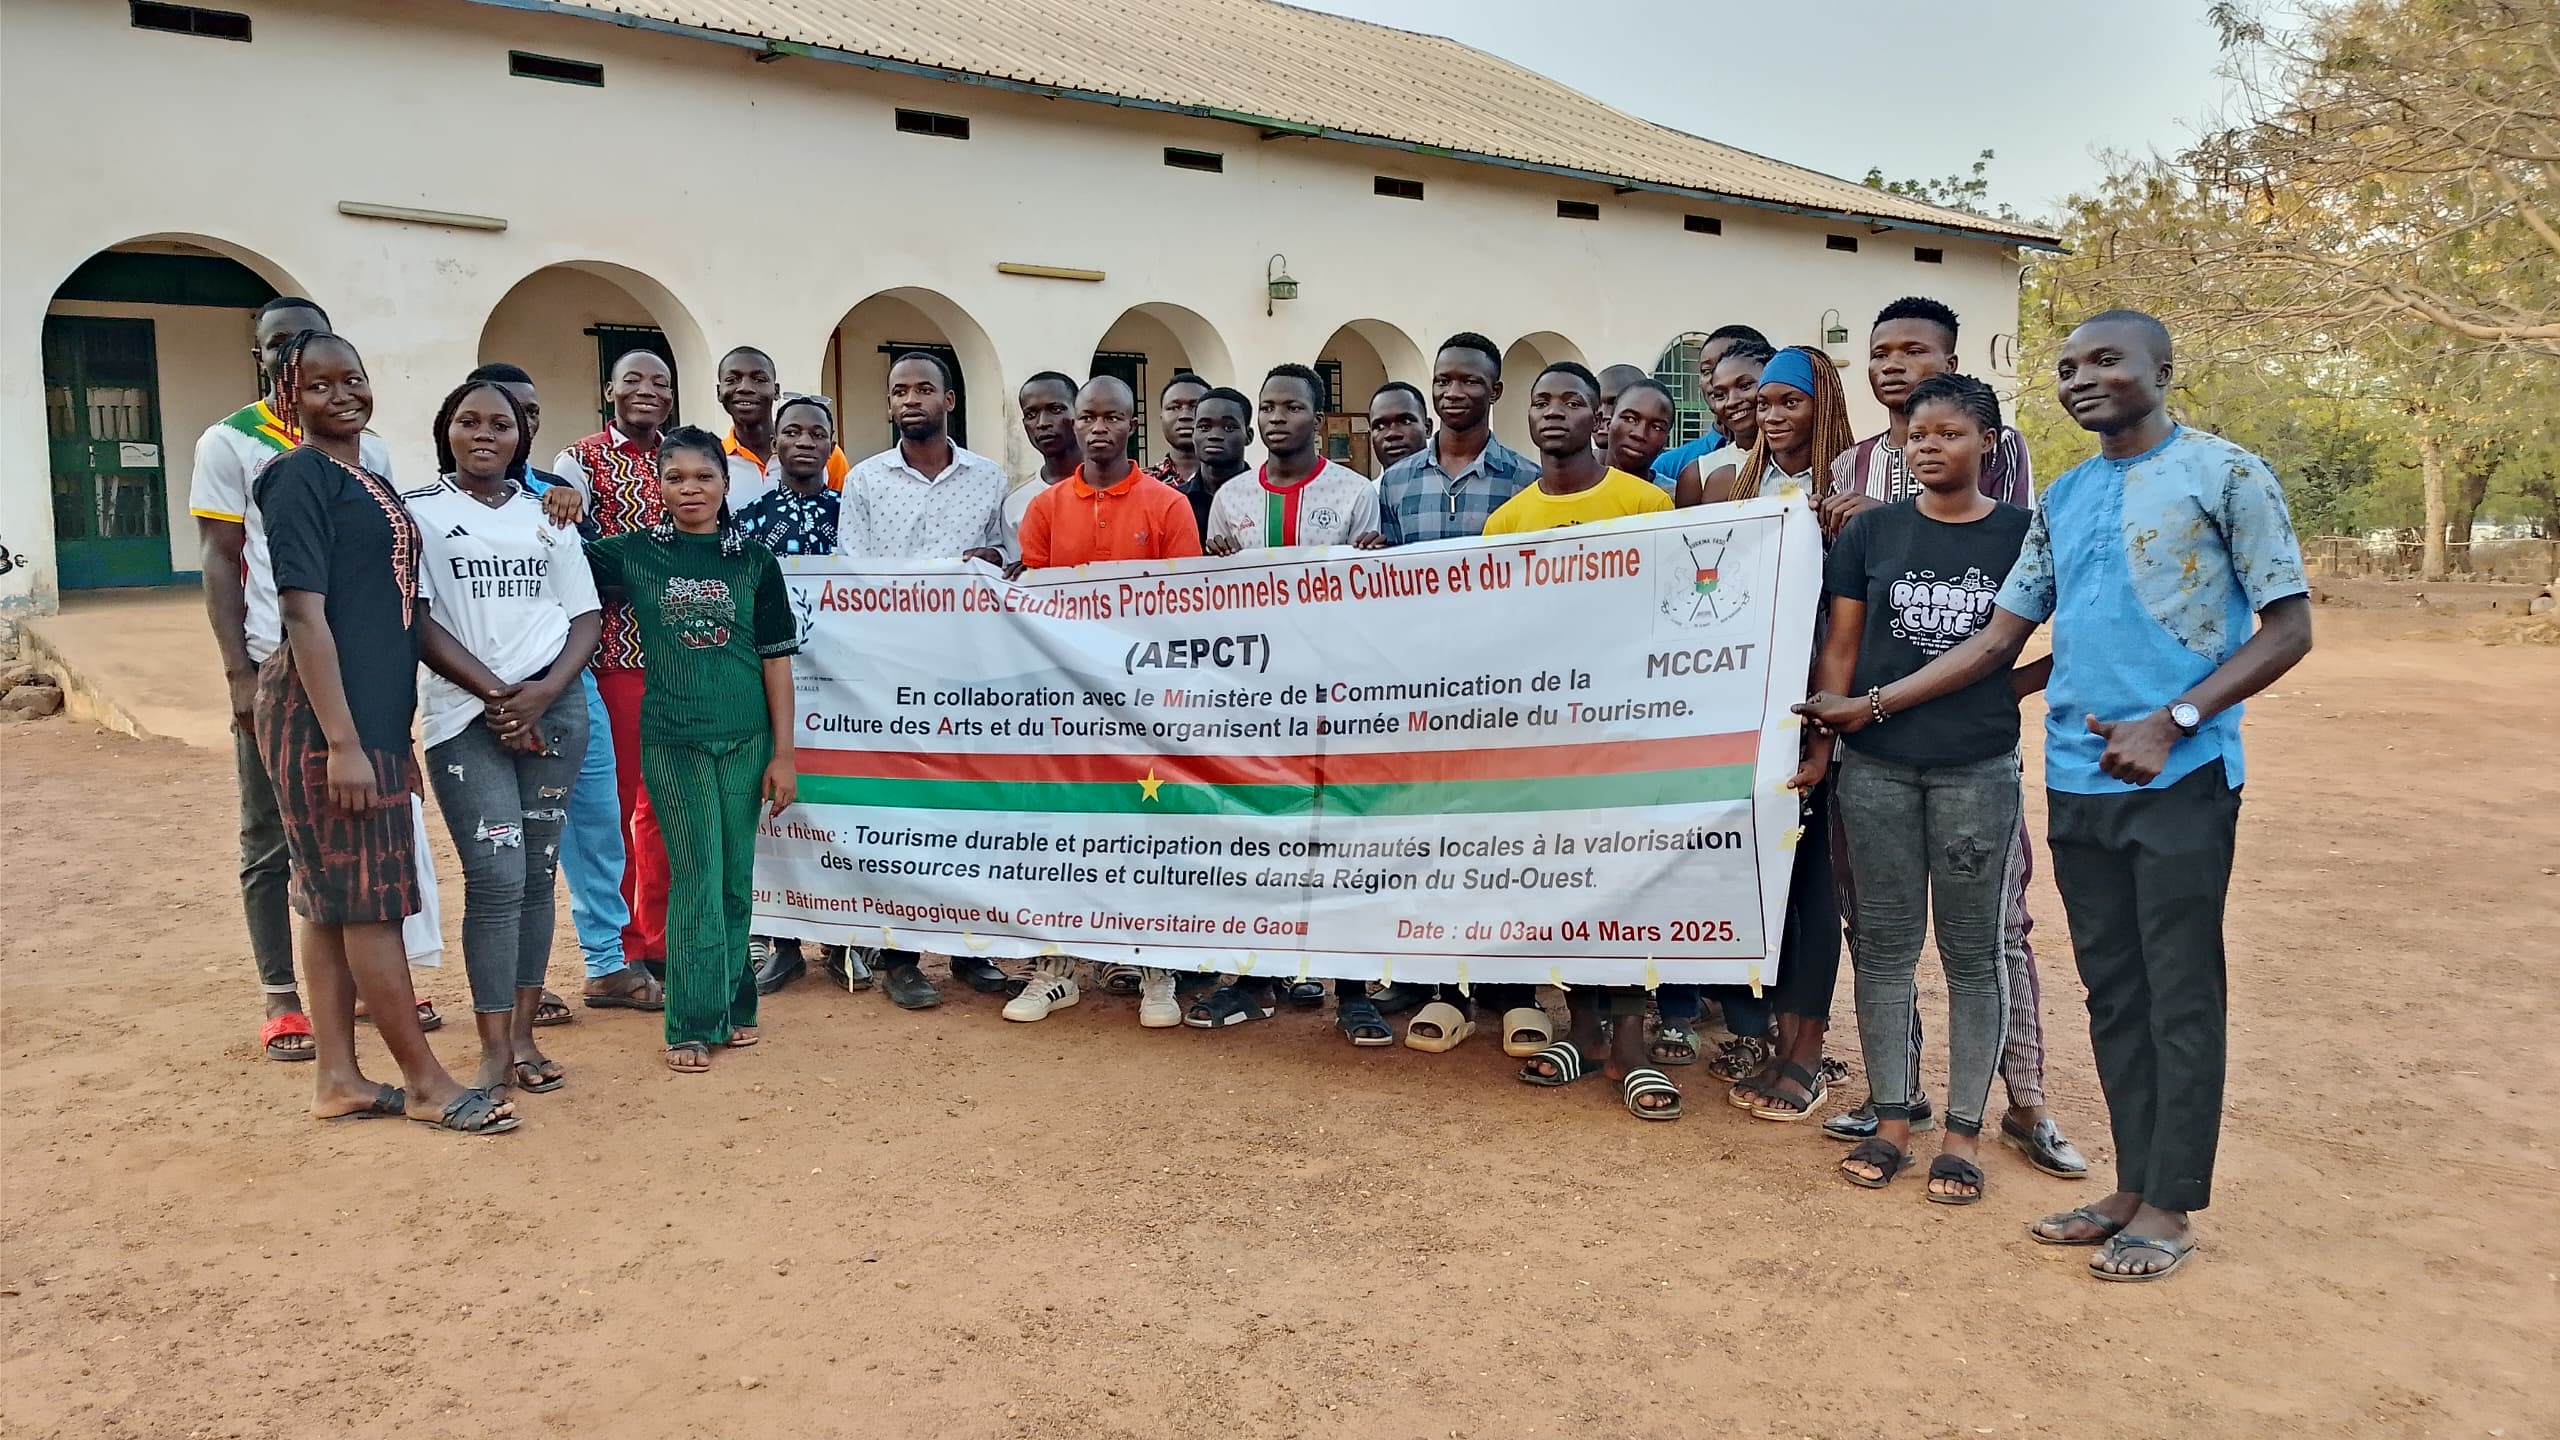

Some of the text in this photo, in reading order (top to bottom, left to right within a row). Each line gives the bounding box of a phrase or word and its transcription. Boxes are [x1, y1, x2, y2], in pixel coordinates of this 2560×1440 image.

[448, 555, 549, 579] Emirates
[819, 579, 955, 612] Association
[962, 580, 1000, 612] des
[1119, 571, 1290, 617] Professionnels
[1349, 562, 1439, 600] Culture
[1447, 556, 1472, 593] et
[1479, 553, 1511, 590] du
[1519, 543, 1640, 586] Tourisme
[472, 579, 541, 599] FLY BETTER
[1893, 583, 1994, 613] RABBIT
[1903, 605, 1974, 634] CUTE
[1125, 633, 1270, 675] (AEPCT)
[1647, 643, 1755, 678] MCCAT
[897, 687, 925, 705] En
[933, 687, 1074, 706] collaboration
[1083, 691, 1126, 707] avec
[1134, 688, 1154, 706] le
[1163, 687, 1272, 708] Ministère
[1280, 685, 1307, 705] de
[1331, 674, 1521, 703] Communication
[1531, 670, 1560, 691] de
[1570, 669, 1591, 690] la
[805, 712, 883, 733] Culture
[890, 716, 930, 735] des
[937, 716, 983, 735] Arts
[990, 718, 1010, 736] et
[1018, 717, 1044, 736] du
[1051, 717, 1147, 737] Tourisme
[1153, 718, 1281, 741] organisent
[1289, 716, 1308, 736] la
[1408, 707, 1518, 732] Mondiale
[1527, 705, 1558, 726] du
[1567, 699, 1694, 724] Tourisme.
[769, 820, 781, 838] le
[787, 822, 836, 842] thème
[856, 825, 957, 848] Tourisme
[965, 830, 1048, 851] durable
[1055, 834, 1076, 852] et
[1082, 834, 1222, 859] participation
[1230, 836, 1270, 856] des
[1440, 836, 1524, 857] locales
[1532, 834, 1546, 855] à
[1554, 833, 1575, 855] la
[1584, 826, 1742, 854] valorisation
[821, 851, 852, 871] des
[858, 857, 980, 878] ressources
[988, 862, 1098, 882] naturelles
[1105, 865, 1127, 883] et
[1133, 864, 1247, 886] culturelles
[1333, 868, 1417, 894] Région
[1425, 869, 1455, 889] du
[1462, 866, 1597, 890] Sud-Ouest.
[786, 889, 857, 912] Bâtiment
[863, 896, 980, 924] Pédagogique
[987, 907, 1009, 924] du
[1016, 908, 1083, 928] Centre
[1090, 911, 1216, 933] Universitaire
[1222, 915, 1246, 933] de
[1397, 919, 1445, 940] Date
[1465, 920, 1492, 941] du
[1561, 920, 1590, 941] 04
[1598, 920, 1662, 941] Mars
[1670, 920, 1741, 942] 2025.
